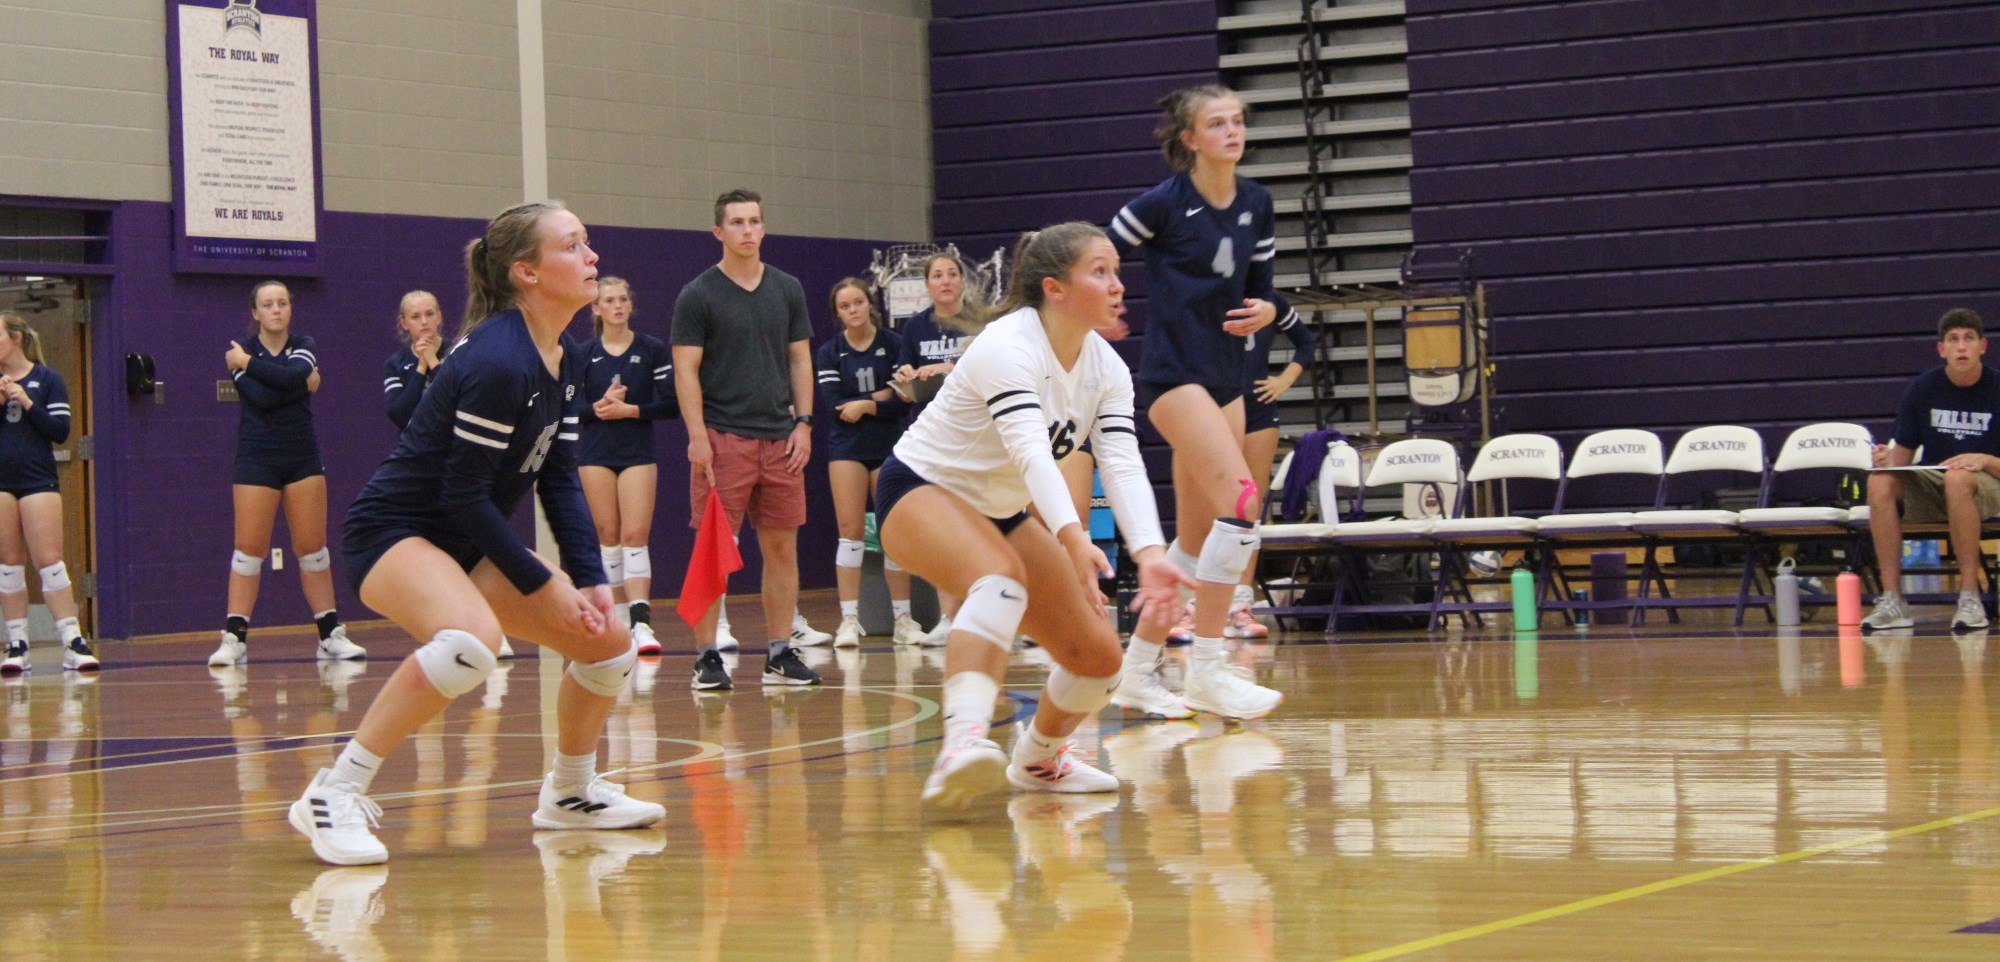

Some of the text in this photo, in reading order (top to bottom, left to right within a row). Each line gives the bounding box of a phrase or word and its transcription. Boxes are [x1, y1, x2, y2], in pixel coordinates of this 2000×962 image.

[208, 47, 280, 64] THE ROYAL WAY
[215, 208, 228, 218] WE
[232, 209, 248, 219] ARE
[193, 245, 307, 257] THE UNIVERSITY OF SCRANTON
[1211, 237, 1236, 279] 4
[855, 367, 875, 392] 11
[1930, 408, 1992, 431] VALLEY
[1937, 428, 1982, 436] VOLLEYBALL
[1048, 420, 1076, 460] 16
[1688, 439, 1748, 453] SCRANTON
[1797, 437, 1858, 450] SCRANTON
[1490, 448, 1545, 461] SCRANTON
[1589, 443, 1647, 457] SCRANTON
[1386, 453, 1442, 467] SCRANTON
